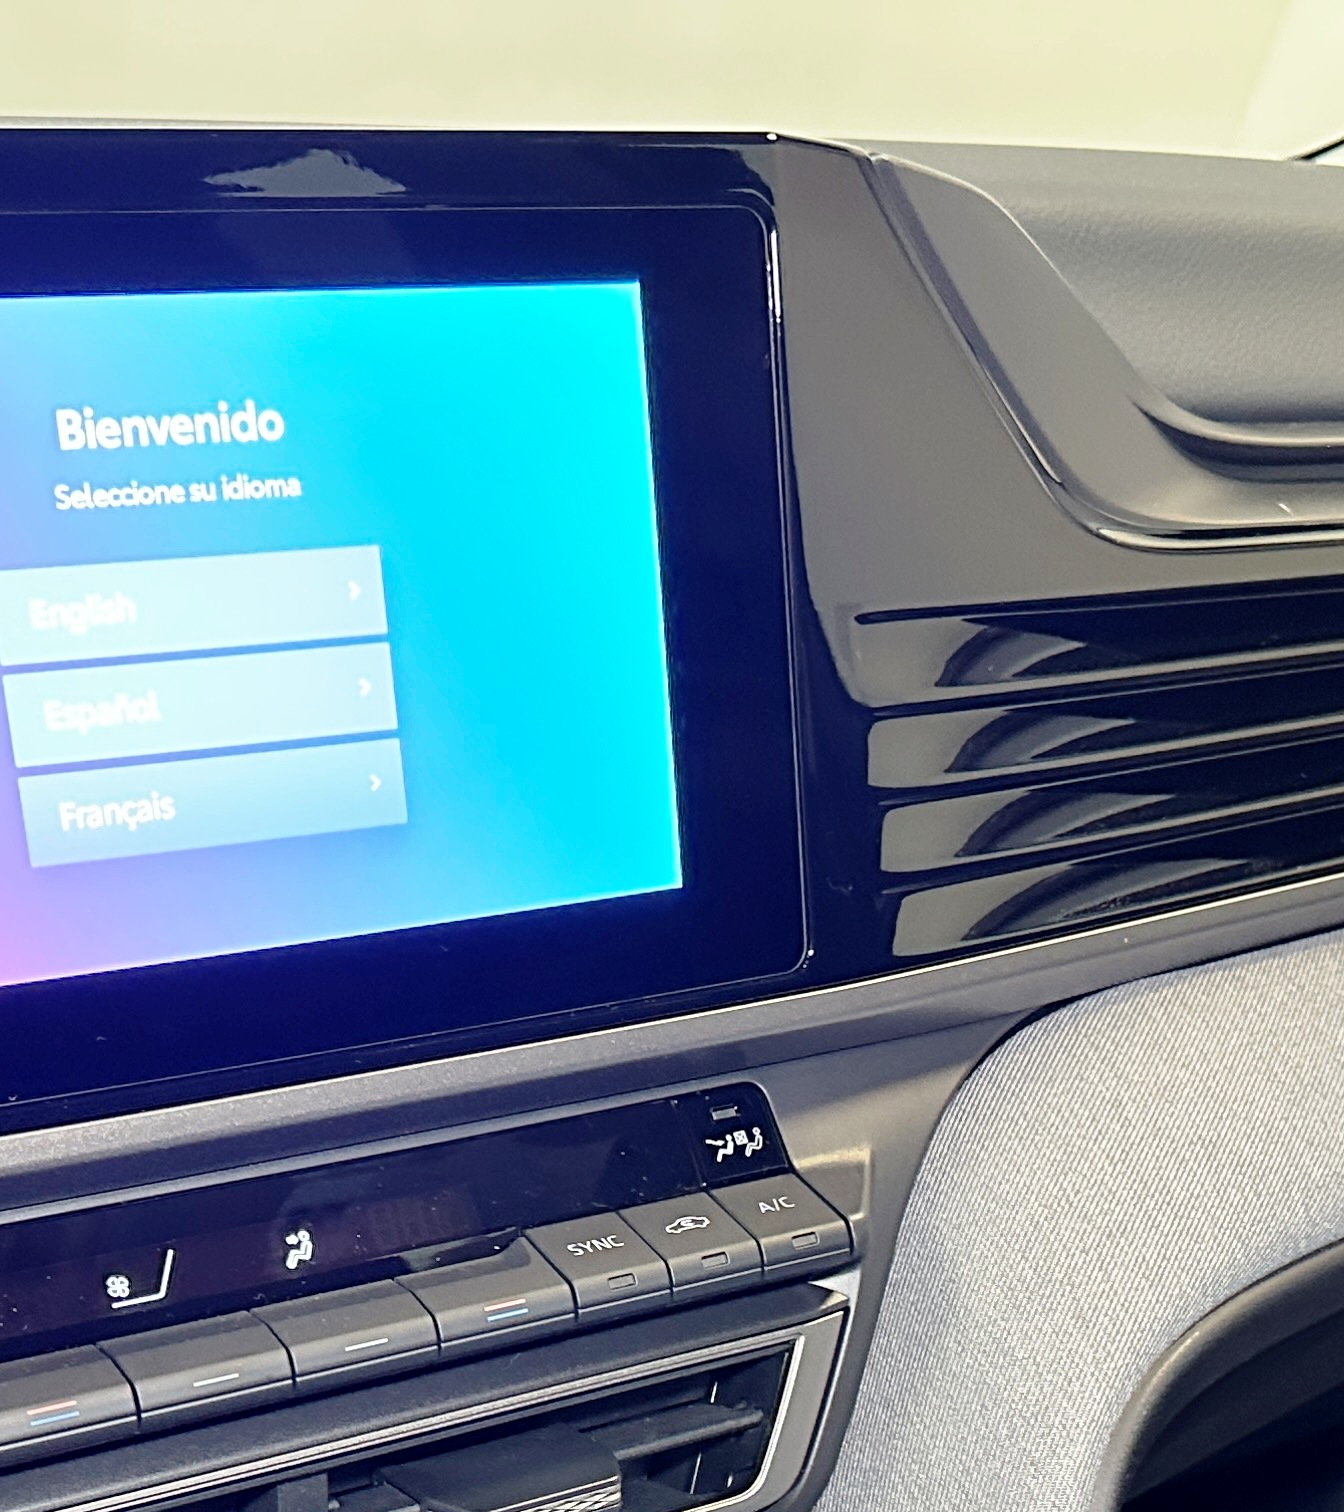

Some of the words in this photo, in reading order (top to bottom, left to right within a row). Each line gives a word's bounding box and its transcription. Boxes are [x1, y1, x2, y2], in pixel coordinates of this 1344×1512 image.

[55, 399, 285, 451] Bienvenido
[54, 480, 186, 511] Seleccione
[189, 482, 217, 504] su
[221, 473, 302, 502] idioma
[27, 592, 137, 635] English
[43, 692, 162, 736] Español
[58, 791, 176, 832] Français
[758, 1196, 795, 1214] A/C
[567, 1235, 624, 1256] SYNC
